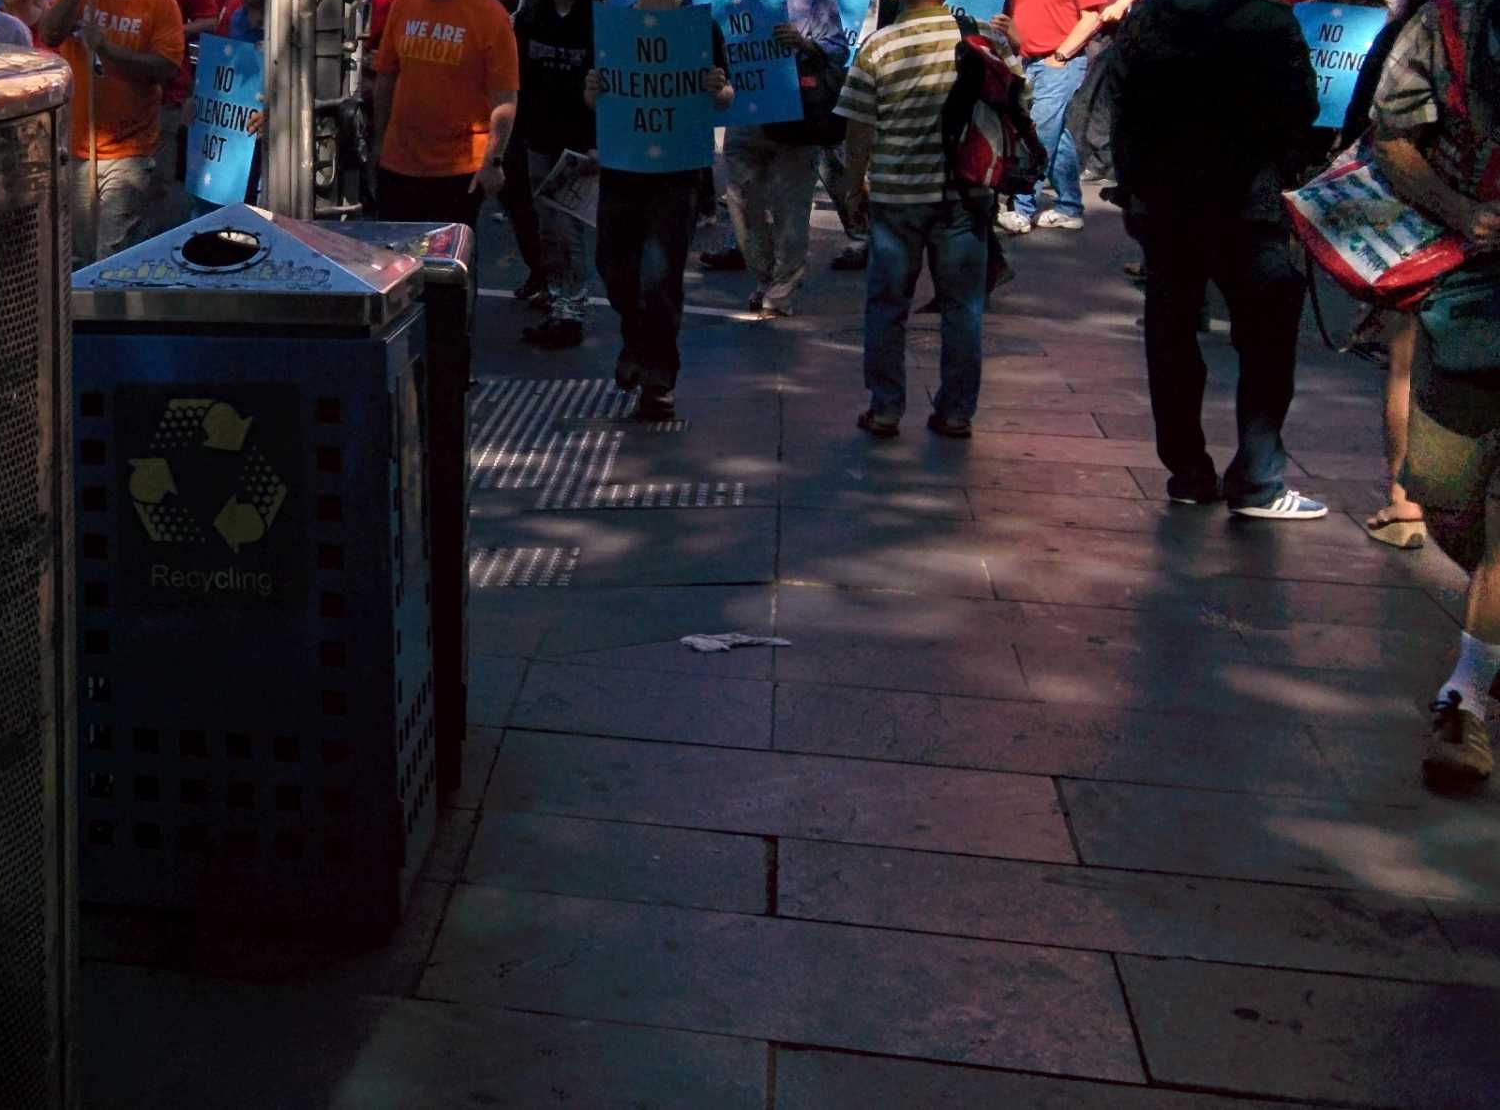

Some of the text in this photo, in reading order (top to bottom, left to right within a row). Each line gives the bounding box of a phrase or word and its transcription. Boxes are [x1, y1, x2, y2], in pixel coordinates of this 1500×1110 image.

[110, 15, 143, 34] ARE
[404, 19, 467, 43] WE ARE
[728, 12, 755, 36] NO
[1319, 24, 1344, 43] NO
[403, 38, 465, 67] UNION
[636, 37, 668, 63] NO
[726, 39, 793, 65] ENCING
[213, 65, 235, 93] NO
[734, 68, 766, 91] ACT
[633, 107, 676, 133] ACT
[202, 134, 228, 163] ACT
[149, 564, 273, 596] Recycling
